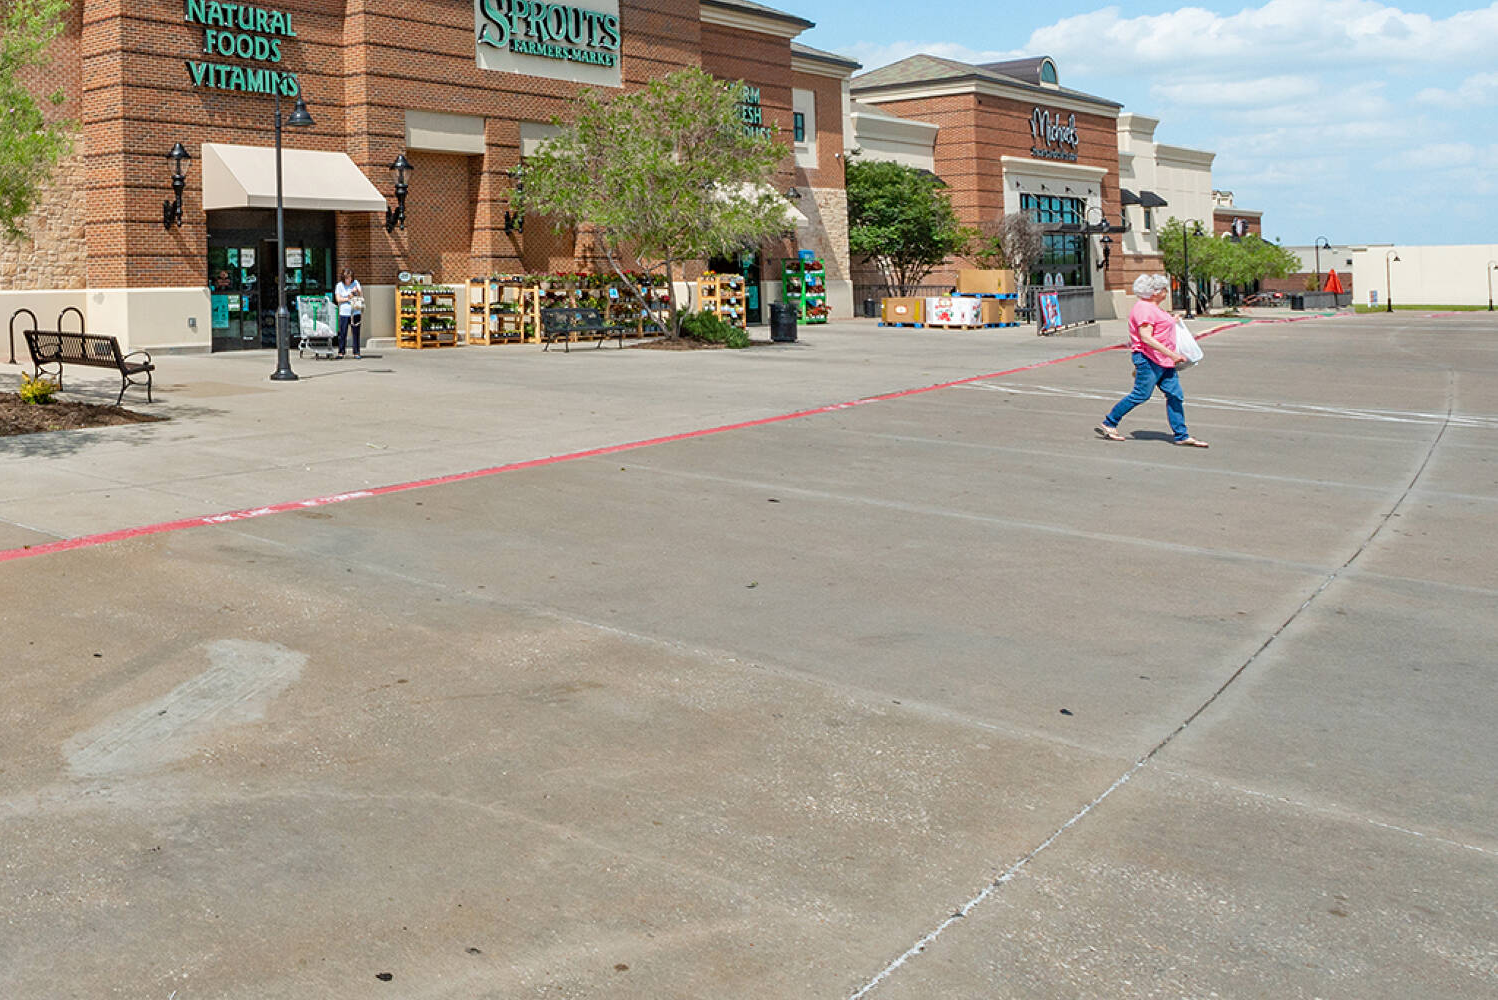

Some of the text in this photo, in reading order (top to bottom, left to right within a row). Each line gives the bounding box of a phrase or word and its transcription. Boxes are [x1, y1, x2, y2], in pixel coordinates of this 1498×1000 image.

[204, 29, 282, 63] FOODS
[512, 39, 619, 68] FARMERS MARKET
[187, 60, 299, 97] VITAMINS
